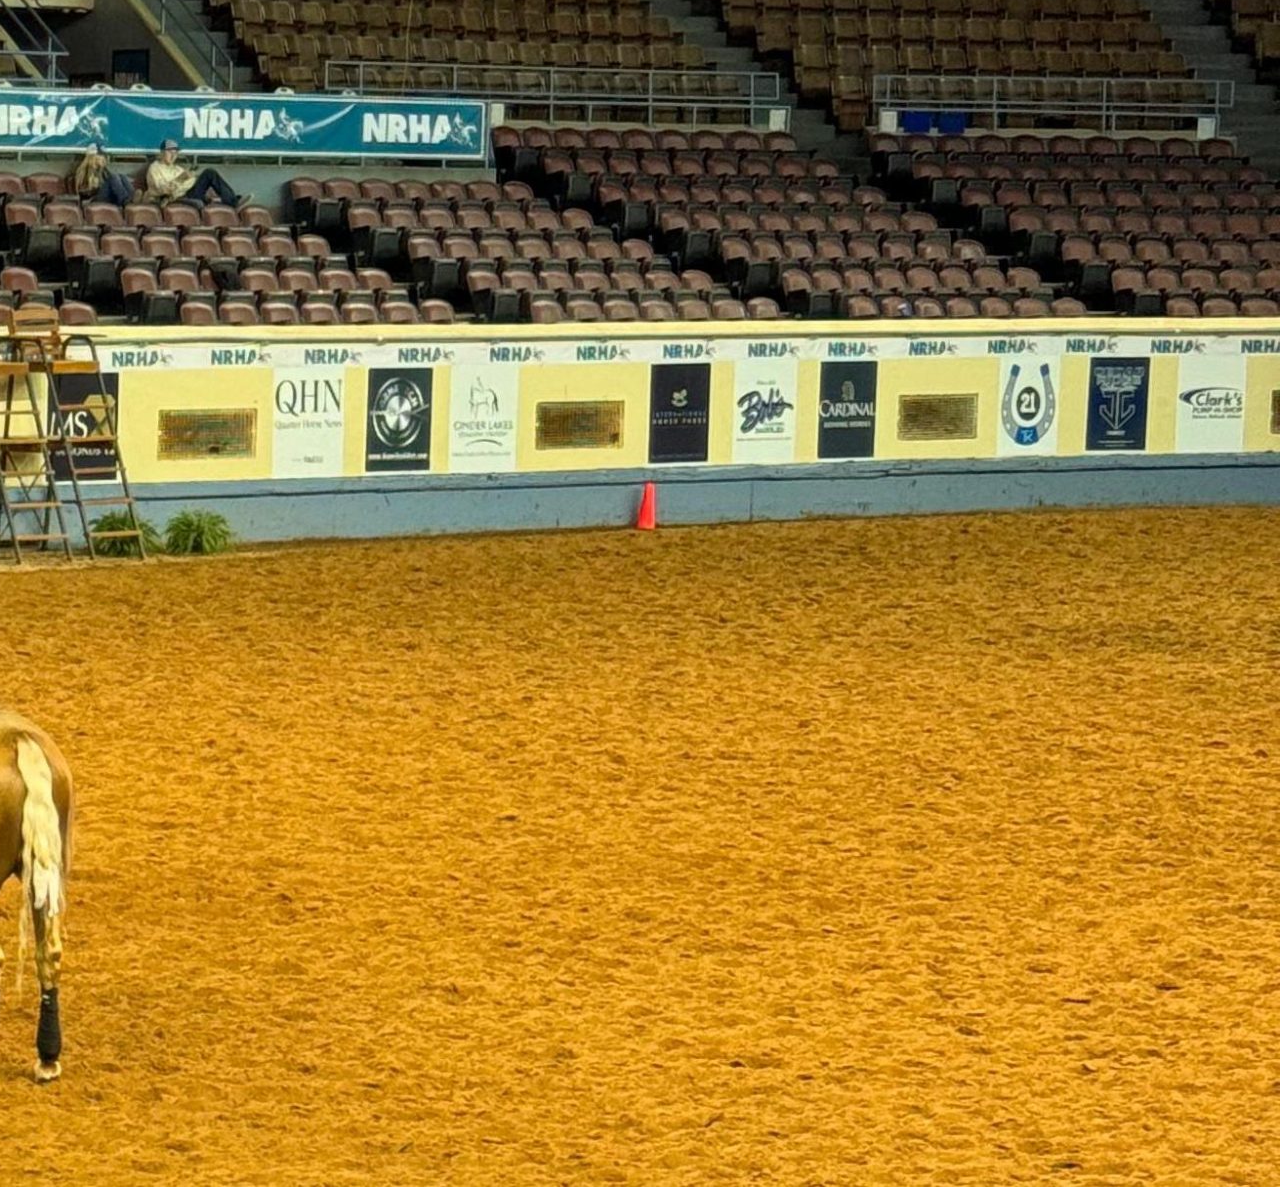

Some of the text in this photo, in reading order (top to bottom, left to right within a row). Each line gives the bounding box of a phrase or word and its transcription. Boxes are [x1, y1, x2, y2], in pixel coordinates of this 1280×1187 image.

[183, 107, 277, 141] NRHA
[362, 112, 452, 144] NRHA
[576, 345, 619, 360] NRHA
[663, 344, 704, 358] NRHA
[748, 343, 788, 357] NRHA
[828, 342, 866, 356] NRHA
[909, 341, 946, 356] NRHA
[987, 340, 1026, 354] NRHA
[1066, 339, 1106, 353] NRHA
[1150, 339, 1194, 353] NRHA
[1241, 339, 1280, 353] NRH
[111, 351, 159, 367] NRHA
[211, 349, 257, 365] NRHA
[304, 348, 349, 364] NRHA
[398, 347, 442, 363] NRHA
[489, 347, 532, 362] NRHA
[275, 379, 343, 417] QHN
[1019, 392, 1036, 414] 21
[1196, 392, 1243, 406] Clark's
[820, 400, 875, 417] CARDINAL
